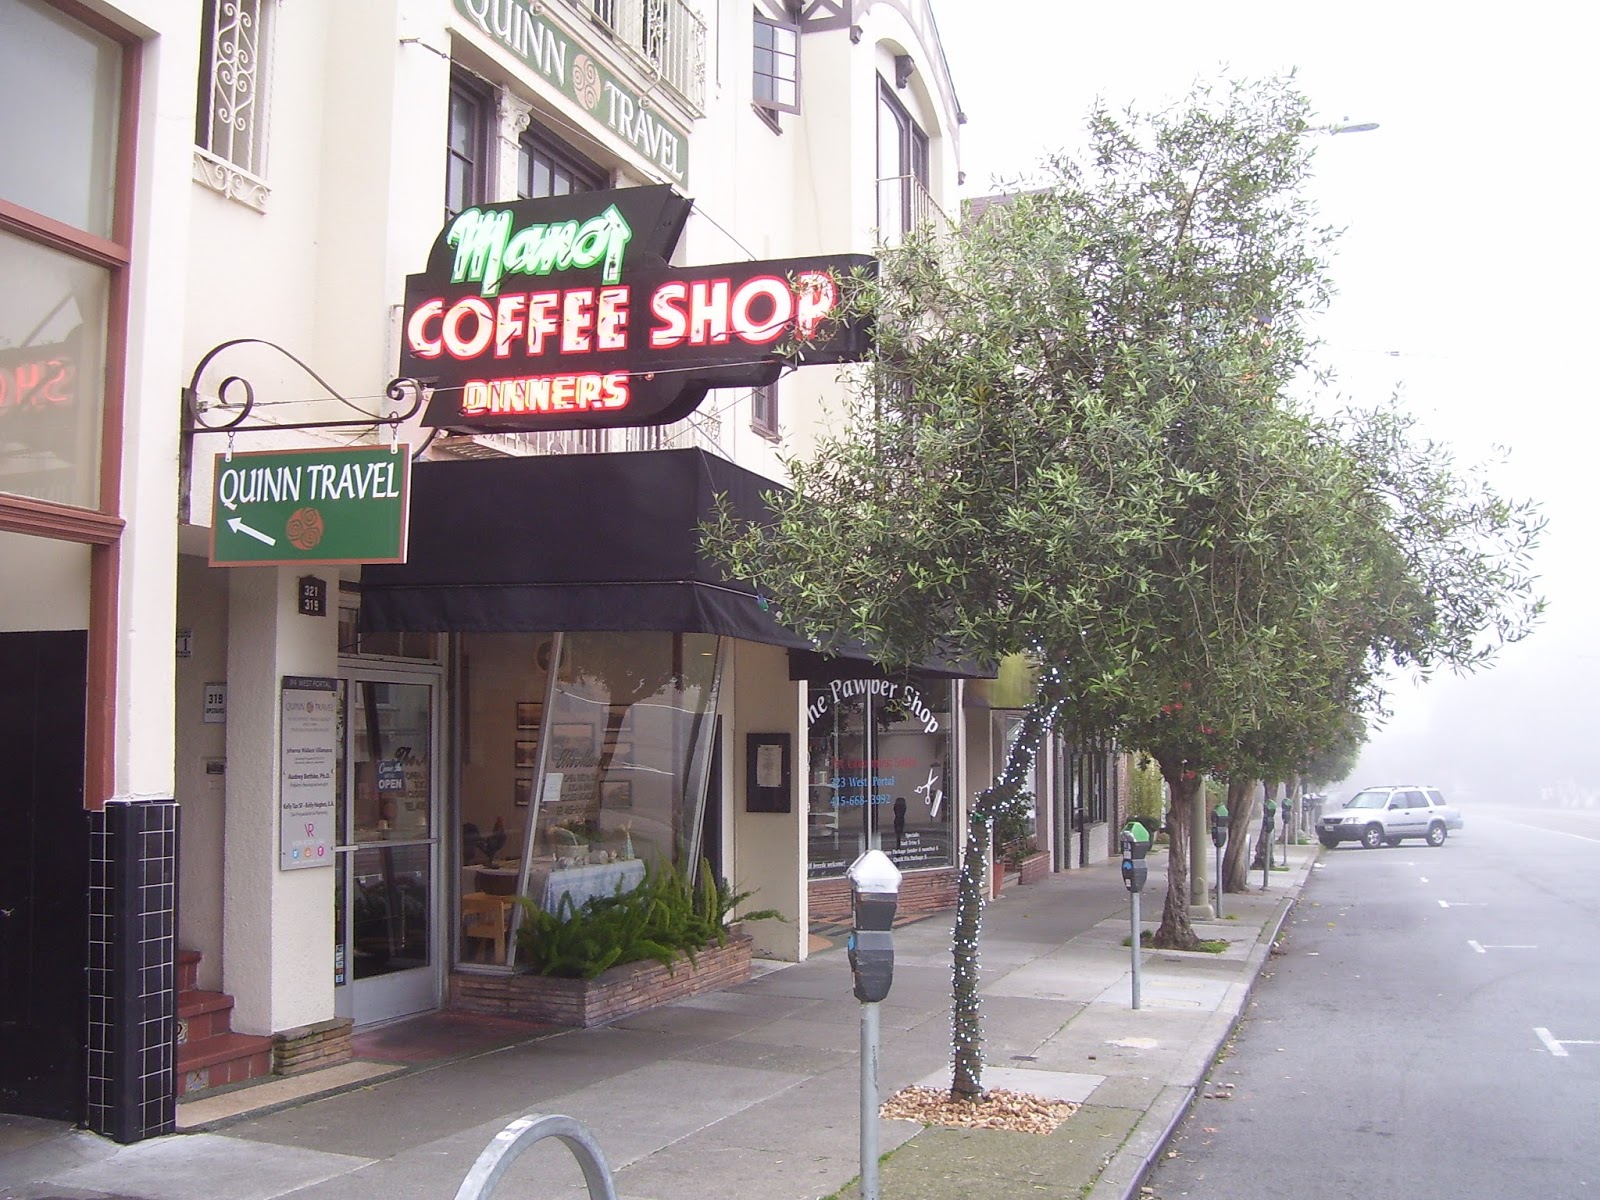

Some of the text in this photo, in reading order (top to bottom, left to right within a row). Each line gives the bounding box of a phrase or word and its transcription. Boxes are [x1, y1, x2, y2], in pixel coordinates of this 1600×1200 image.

[604, 80, 684, 181] TRAVEL
[447, 203, 633, 298] Manor
[406, 270, 837, 361] COFFEE SHOP
[461, 370, 630, 417] DINNERS
[218, 461, 400, 511] QUINN TRAVEL
[304, 585, 318, 597] 321
[304, 599, 319, 611] 319
[312, 680, 332, 688] PORTAL
[285, 702, 335, 712] QUINN TRAVEL
[900, 685, 939, 734] Shop
[378, 778, 402, 789] OPEN
[830, 775, 896, 789] 323 West Portal
